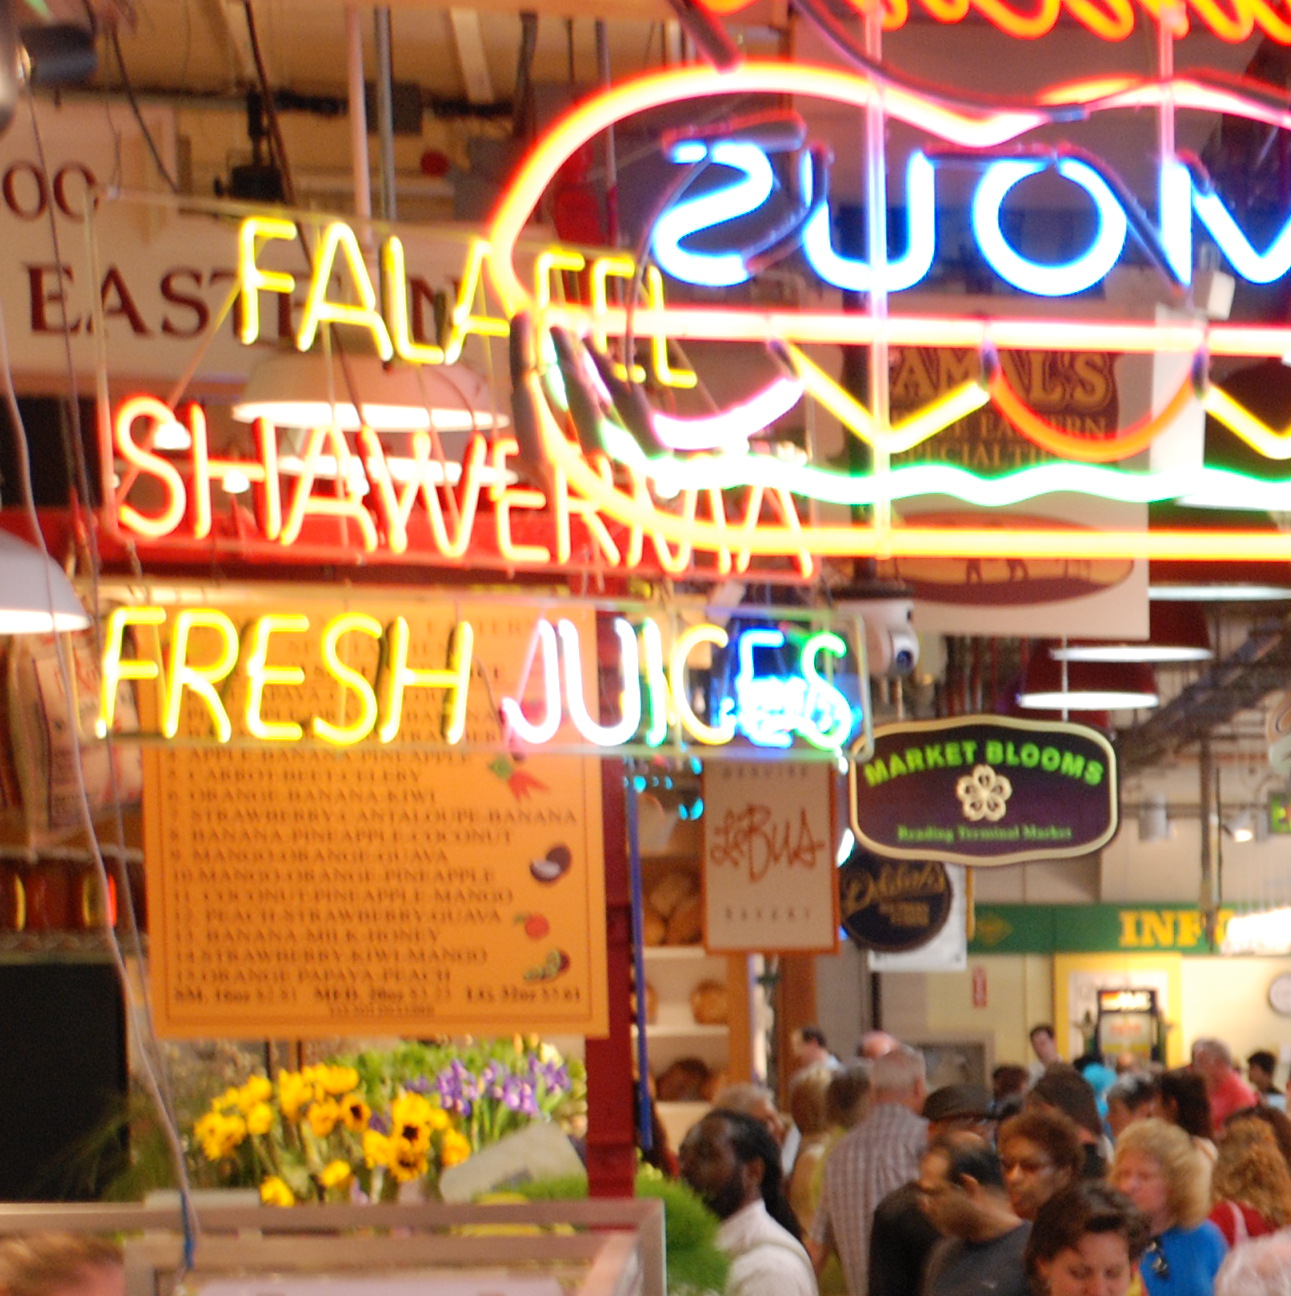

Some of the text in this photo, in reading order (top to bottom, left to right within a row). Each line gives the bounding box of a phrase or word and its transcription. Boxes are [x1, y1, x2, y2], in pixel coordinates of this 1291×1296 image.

[26, 261, 468, 340] EASTEN
[239, 216, 697, 388] FALAFEL
[95, 607, 857, 751] FRESH JUICES
[864, 740, 1105, 787] MARKET BLOOMS
[897, 825, 1072, 844] Reading Terminal Market
